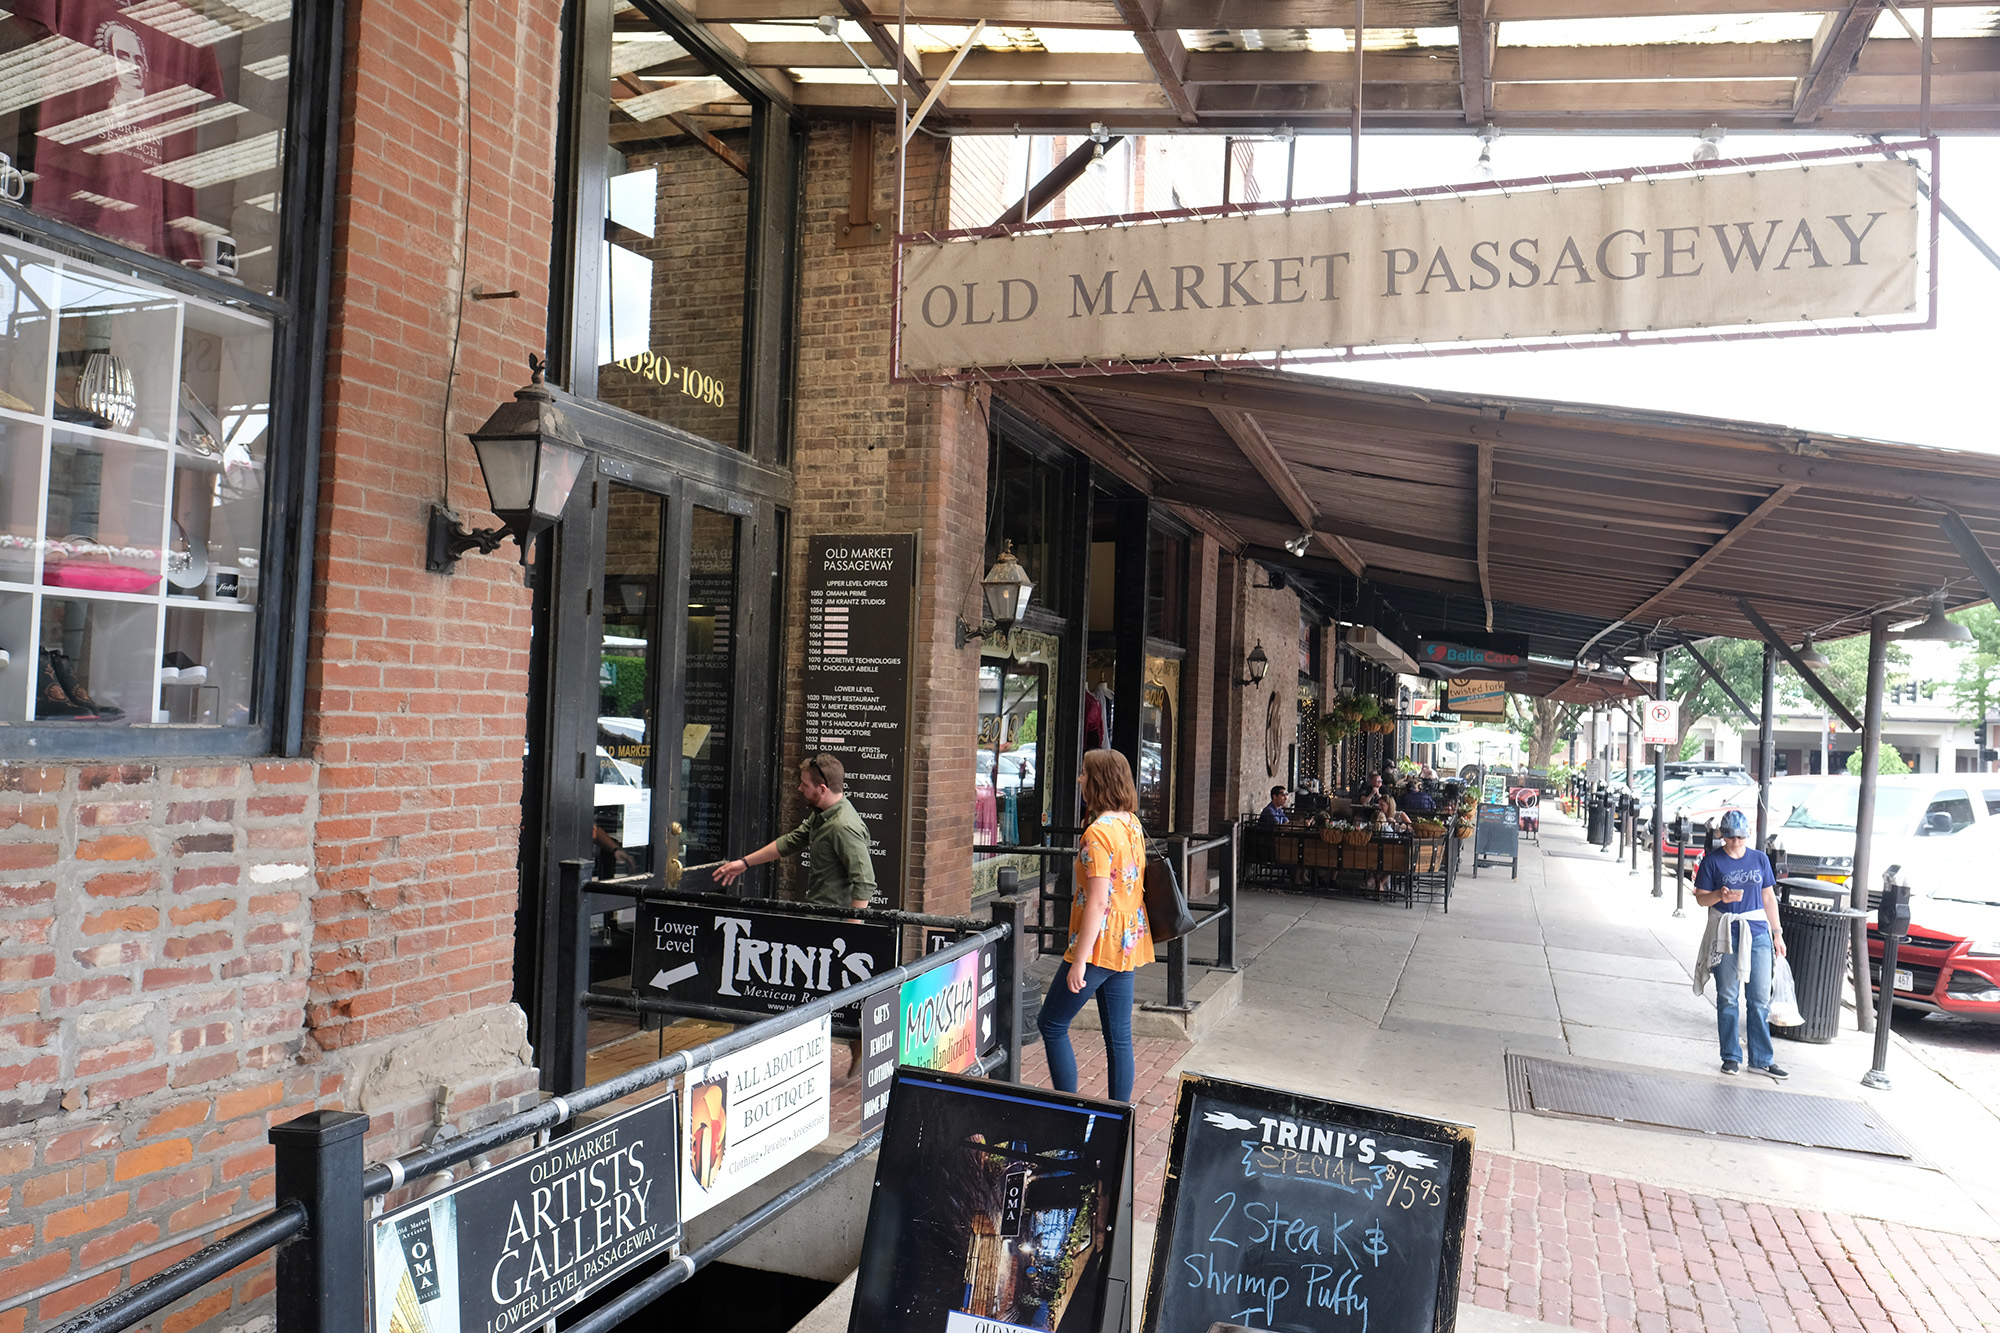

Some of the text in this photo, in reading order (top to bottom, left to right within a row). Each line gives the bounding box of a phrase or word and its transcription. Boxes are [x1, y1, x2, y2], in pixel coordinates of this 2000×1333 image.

[921, 212, 1888, 328] OLD MARKET PASSAGEWAY
[825, 547, 894, 559] OLD MARKET
[823, 560, 894, 571] PASSAGEWAY
[855, 657, 901, 665] TECHNOLOGIES
[1447, 648, 1519, 664] BellaCare
[842, 695, 880, 703] RESTAURANT
[1450, 681, 1504, 697] twisted fork
[848, 704, 886, 712] RESTAURANT
[833, 720, 870, 728] HANDCRAFT
[871, 721, 898, 729] JEWELRY
[618, 745, 651, 757] MARKET
[861, 752, 888, 760] GALLERY
[860, 773, 891, 781] ENTRANCE
[865, 792, 888, 800] ZODIAC
[654, 917, 698, 936] Lower
[656, 935, 695, 954] Level
[714, 916, 874, 997] TRINI'S
[743, 985, 797, 1002] Mexican
[873, 1003, 890, 1025] GIFTS
[905, 973, 974, 1055] MOKSHA
[869, 1030, 894, 1058] JEWELRY
[932, 1029, 971, 1071] Handicrafts
[733, 1036, 825, 1094] ALL ABOUT ME!
[743, 1077, 815, 1128] BOUTIQUE
[863, 1095, 880, 1121] HOME
[729, 1114, 825, 1175] Clothing Jewelry Accessories
[1258, 1117, 1377, 1163] TRINI'S
[530, 1128, 619, 1185] OLD MARKET
[1257, 1145, 1372, 1185] SPECIAL
[501, 1140, 645, 1254] ARTISTS
[397, 1217, 431, 1235] Old Market
[1208, 1192, 1239, 1248] 2
[491, 1179, 653, 1306] GALLERY
[486, 1223, 659, 1333] LOWER LEVEL PASSAGEWAY
[1183, 1253, 1369, 1333] Shrimp Puffy
